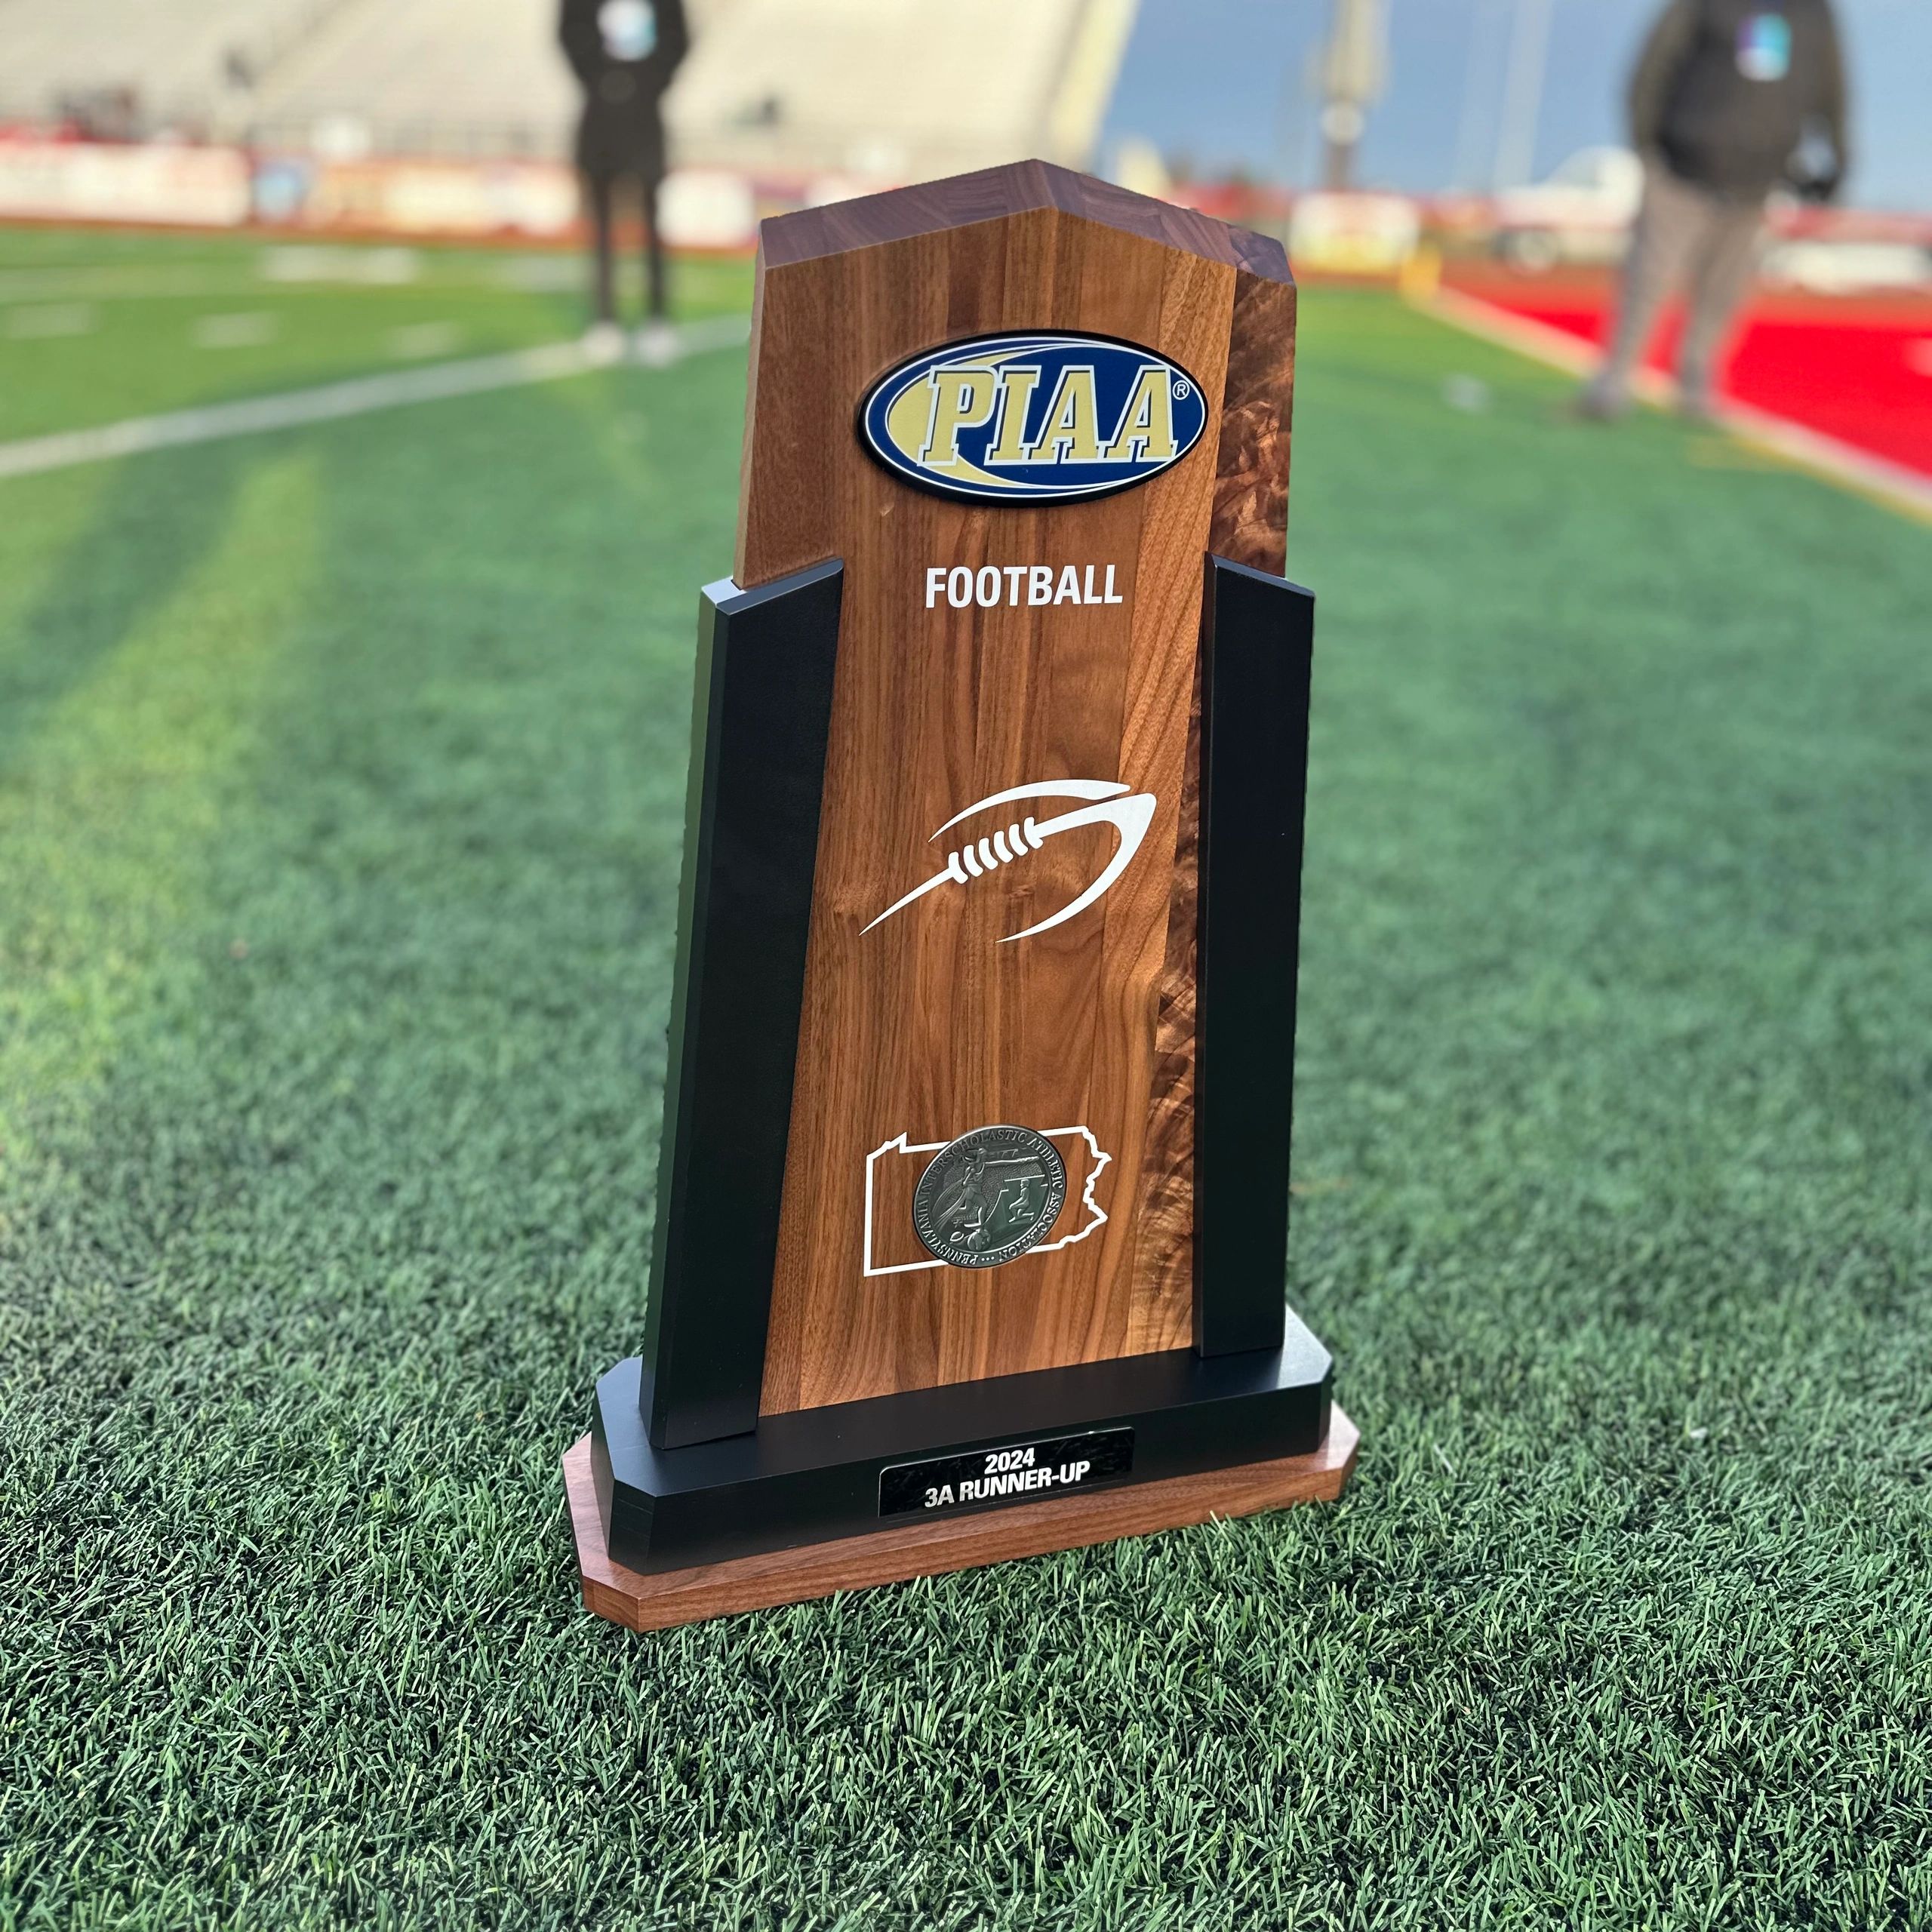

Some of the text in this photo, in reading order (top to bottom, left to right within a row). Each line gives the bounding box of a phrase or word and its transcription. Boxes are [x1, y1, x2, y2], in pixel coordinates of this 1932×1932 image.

[916, 365, 1178, 466] PIAA
[925, 565, 1123, 608] FOOTBALL
[919, 1129, 1027, 1195] INTERSCHOLASTIC
[918, 1199, 979, 1265] PENNSYLVANIA
[998, 1192, 1062, 1263] ASSOCIATION
[924, 1460, 1091, 1508] 3A RUNNER-UP
[984, 1447, 1035, 1474] 2024
